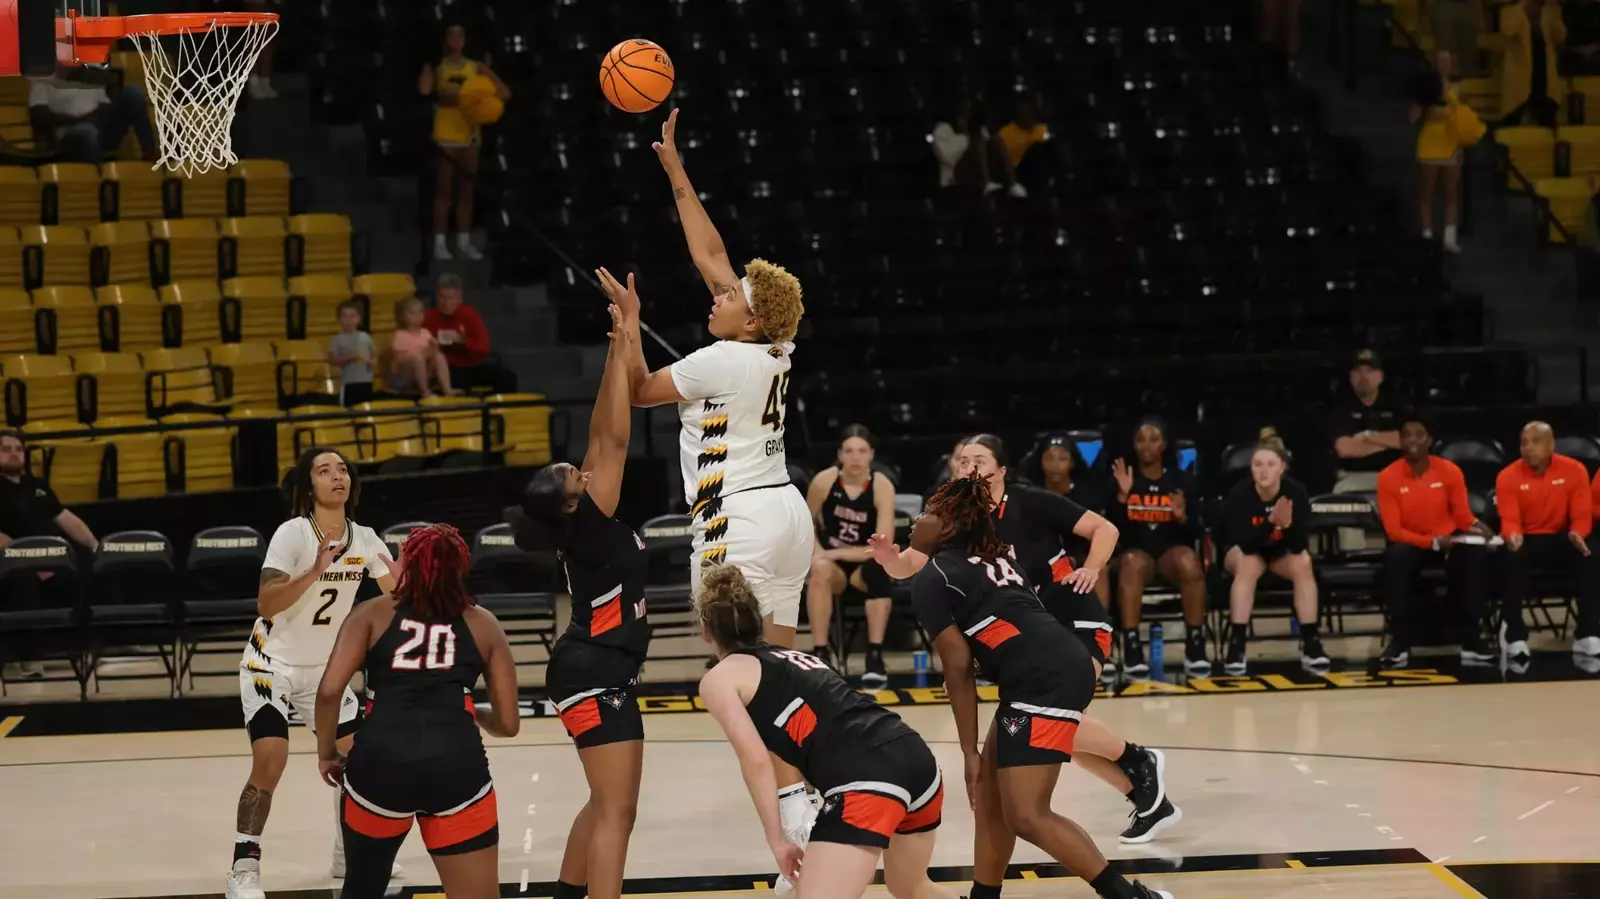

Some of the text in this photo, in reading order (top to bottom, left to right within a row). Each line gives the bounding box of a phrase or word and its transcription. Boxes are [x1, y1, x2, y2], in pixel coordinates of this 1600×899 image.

[838, 521, 860, 541] 25
[316, 570, 364, 581] THERN MISS
[312, 588, 338, 625] 2
[391, 618, 456, 669] 20
